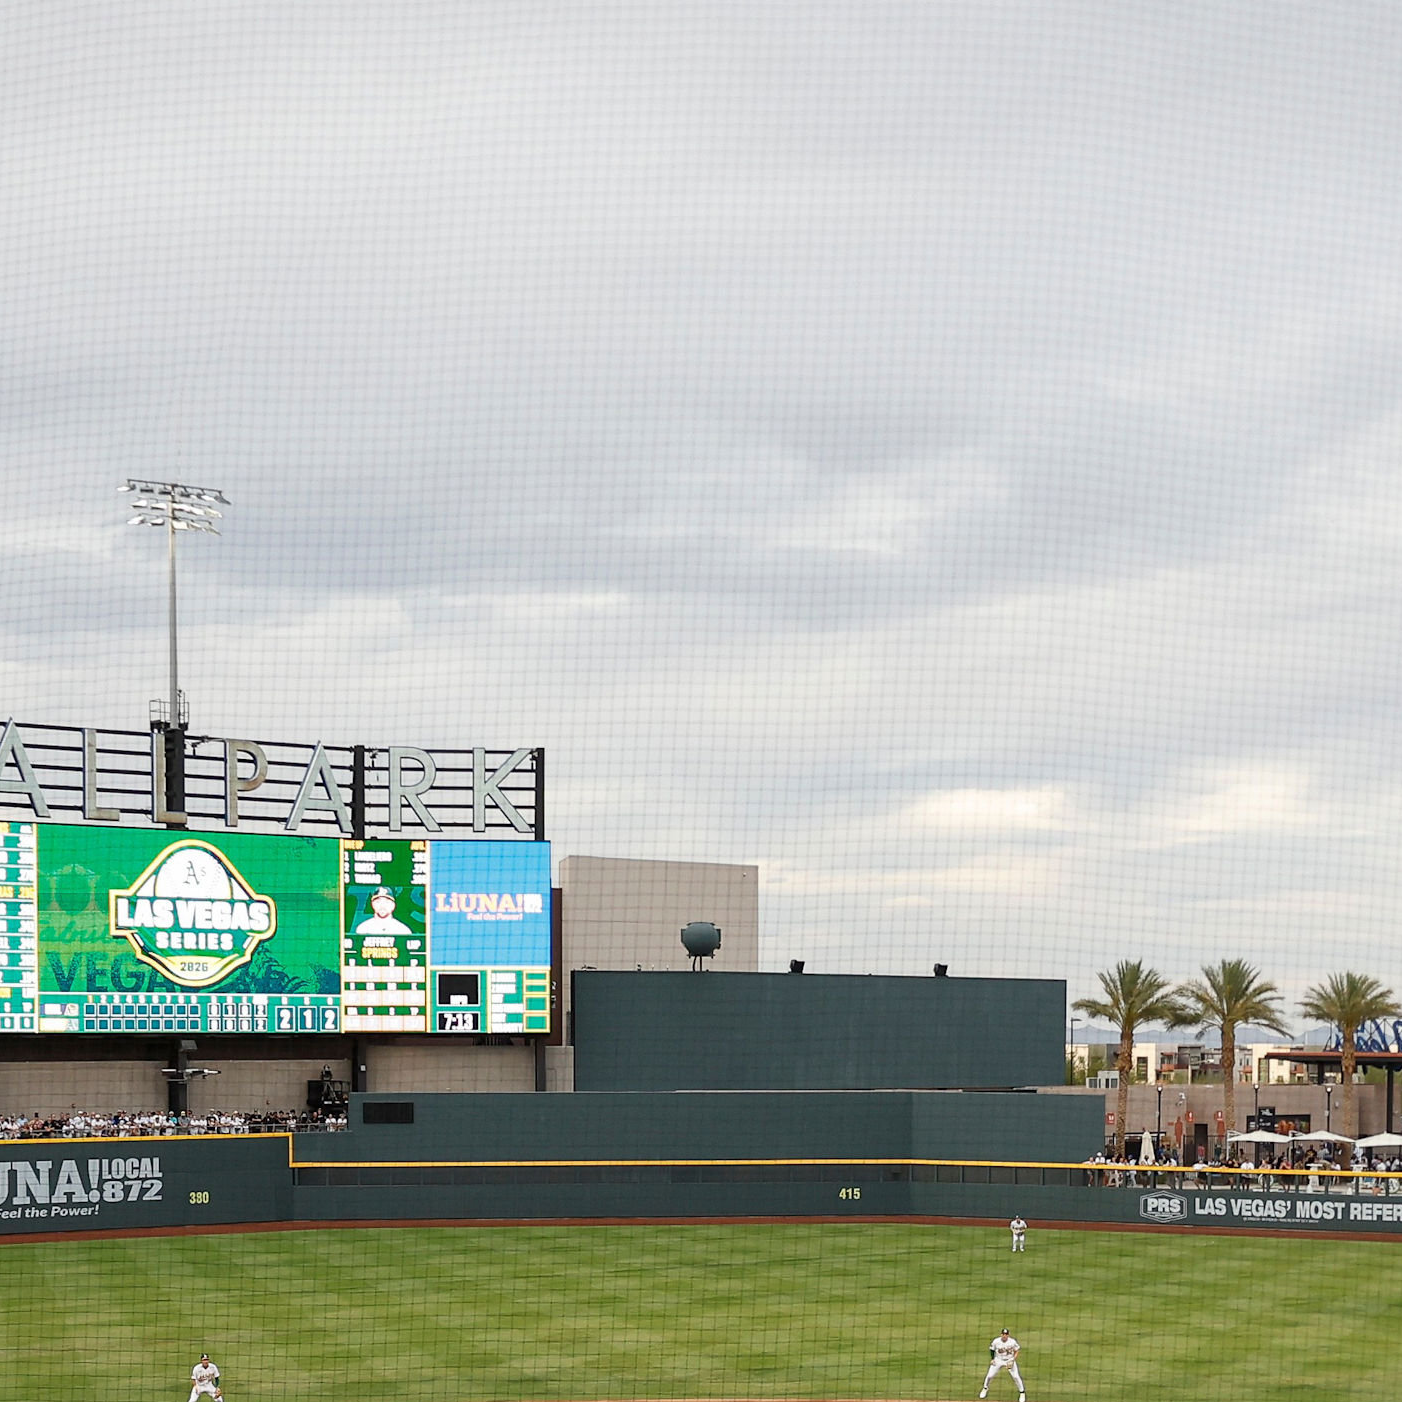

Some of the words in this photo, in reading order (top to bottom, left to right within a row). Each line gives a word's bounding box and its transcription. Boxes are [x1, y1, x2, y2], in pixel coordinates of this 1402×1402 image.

[435, 892, 523, 913] LiUNA!
[117, 897, 175, 929] LAS
[175, 898, 272, 932] VEGAS
[155, 931, 234, 951] SERIES
[362, 948, 398, 958] SPRINGS
[280, 1009, 290, 1029] 2
[303, 1010, 312, 1029] 1
[325, 1010, 335, 1029] 2
[444, 1014, 473, 1030] 7:13
[101, 1157, 163, 1179] LOCAL
[101, 1179, 163, 1203] 872
[189, 1191, 210, 1205] 380
[838, 1187, 862, 1200] 415
[24, 1206, 48, 1218] the
[50, 1204, 100, 1217] Power!
[1147, 1198, 1181, 1213] PRS
[1195, 1197, 1227, 1216] LAS
[1230, 1198, 1291, 1219] VEGAS'
[1295, 1201, 1346, 1220] MOST
